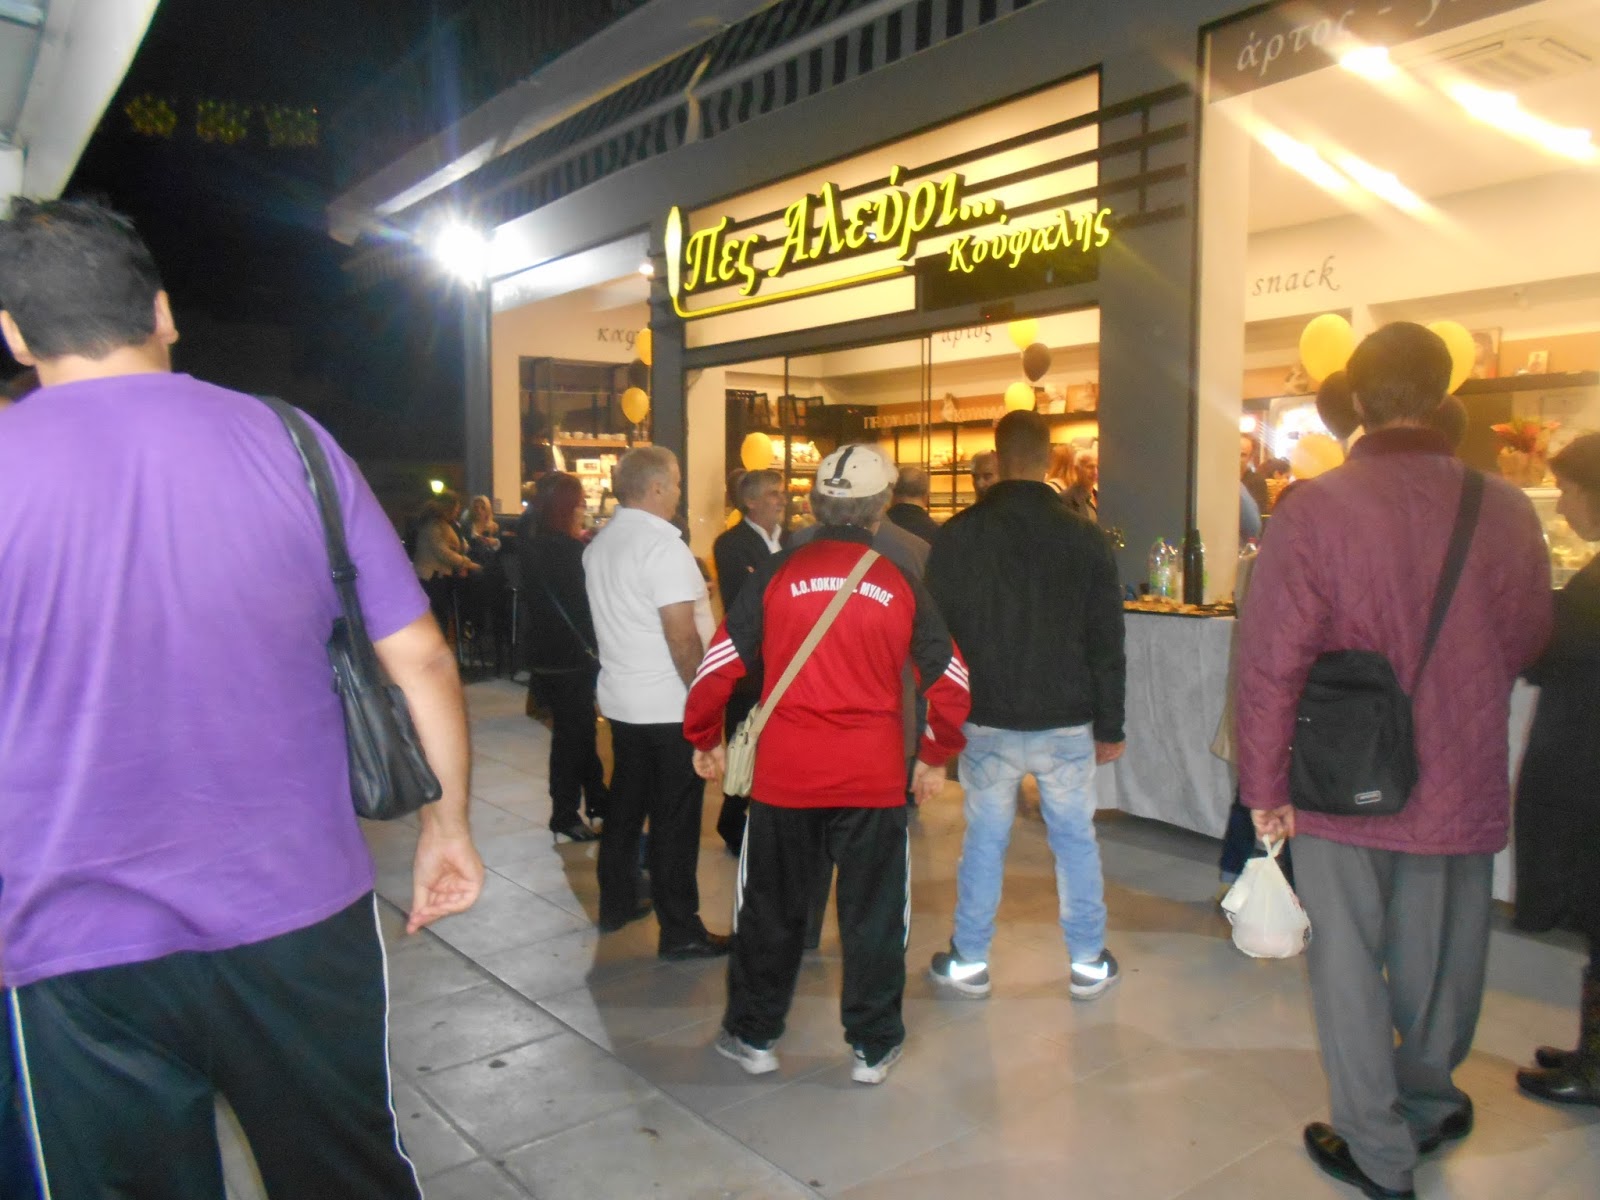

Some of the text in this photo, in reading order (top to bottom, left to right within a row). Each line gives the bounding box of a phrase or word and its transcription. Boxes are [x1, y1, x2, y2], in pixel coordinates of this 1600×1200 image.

[685, 216, 760, 296] Πες
[947, 207, 1112, 274] Κούφαλης
[1252, 254, 1341, 297] snack
[859, 581, 894, 607] ΜΥΛΟΣ
